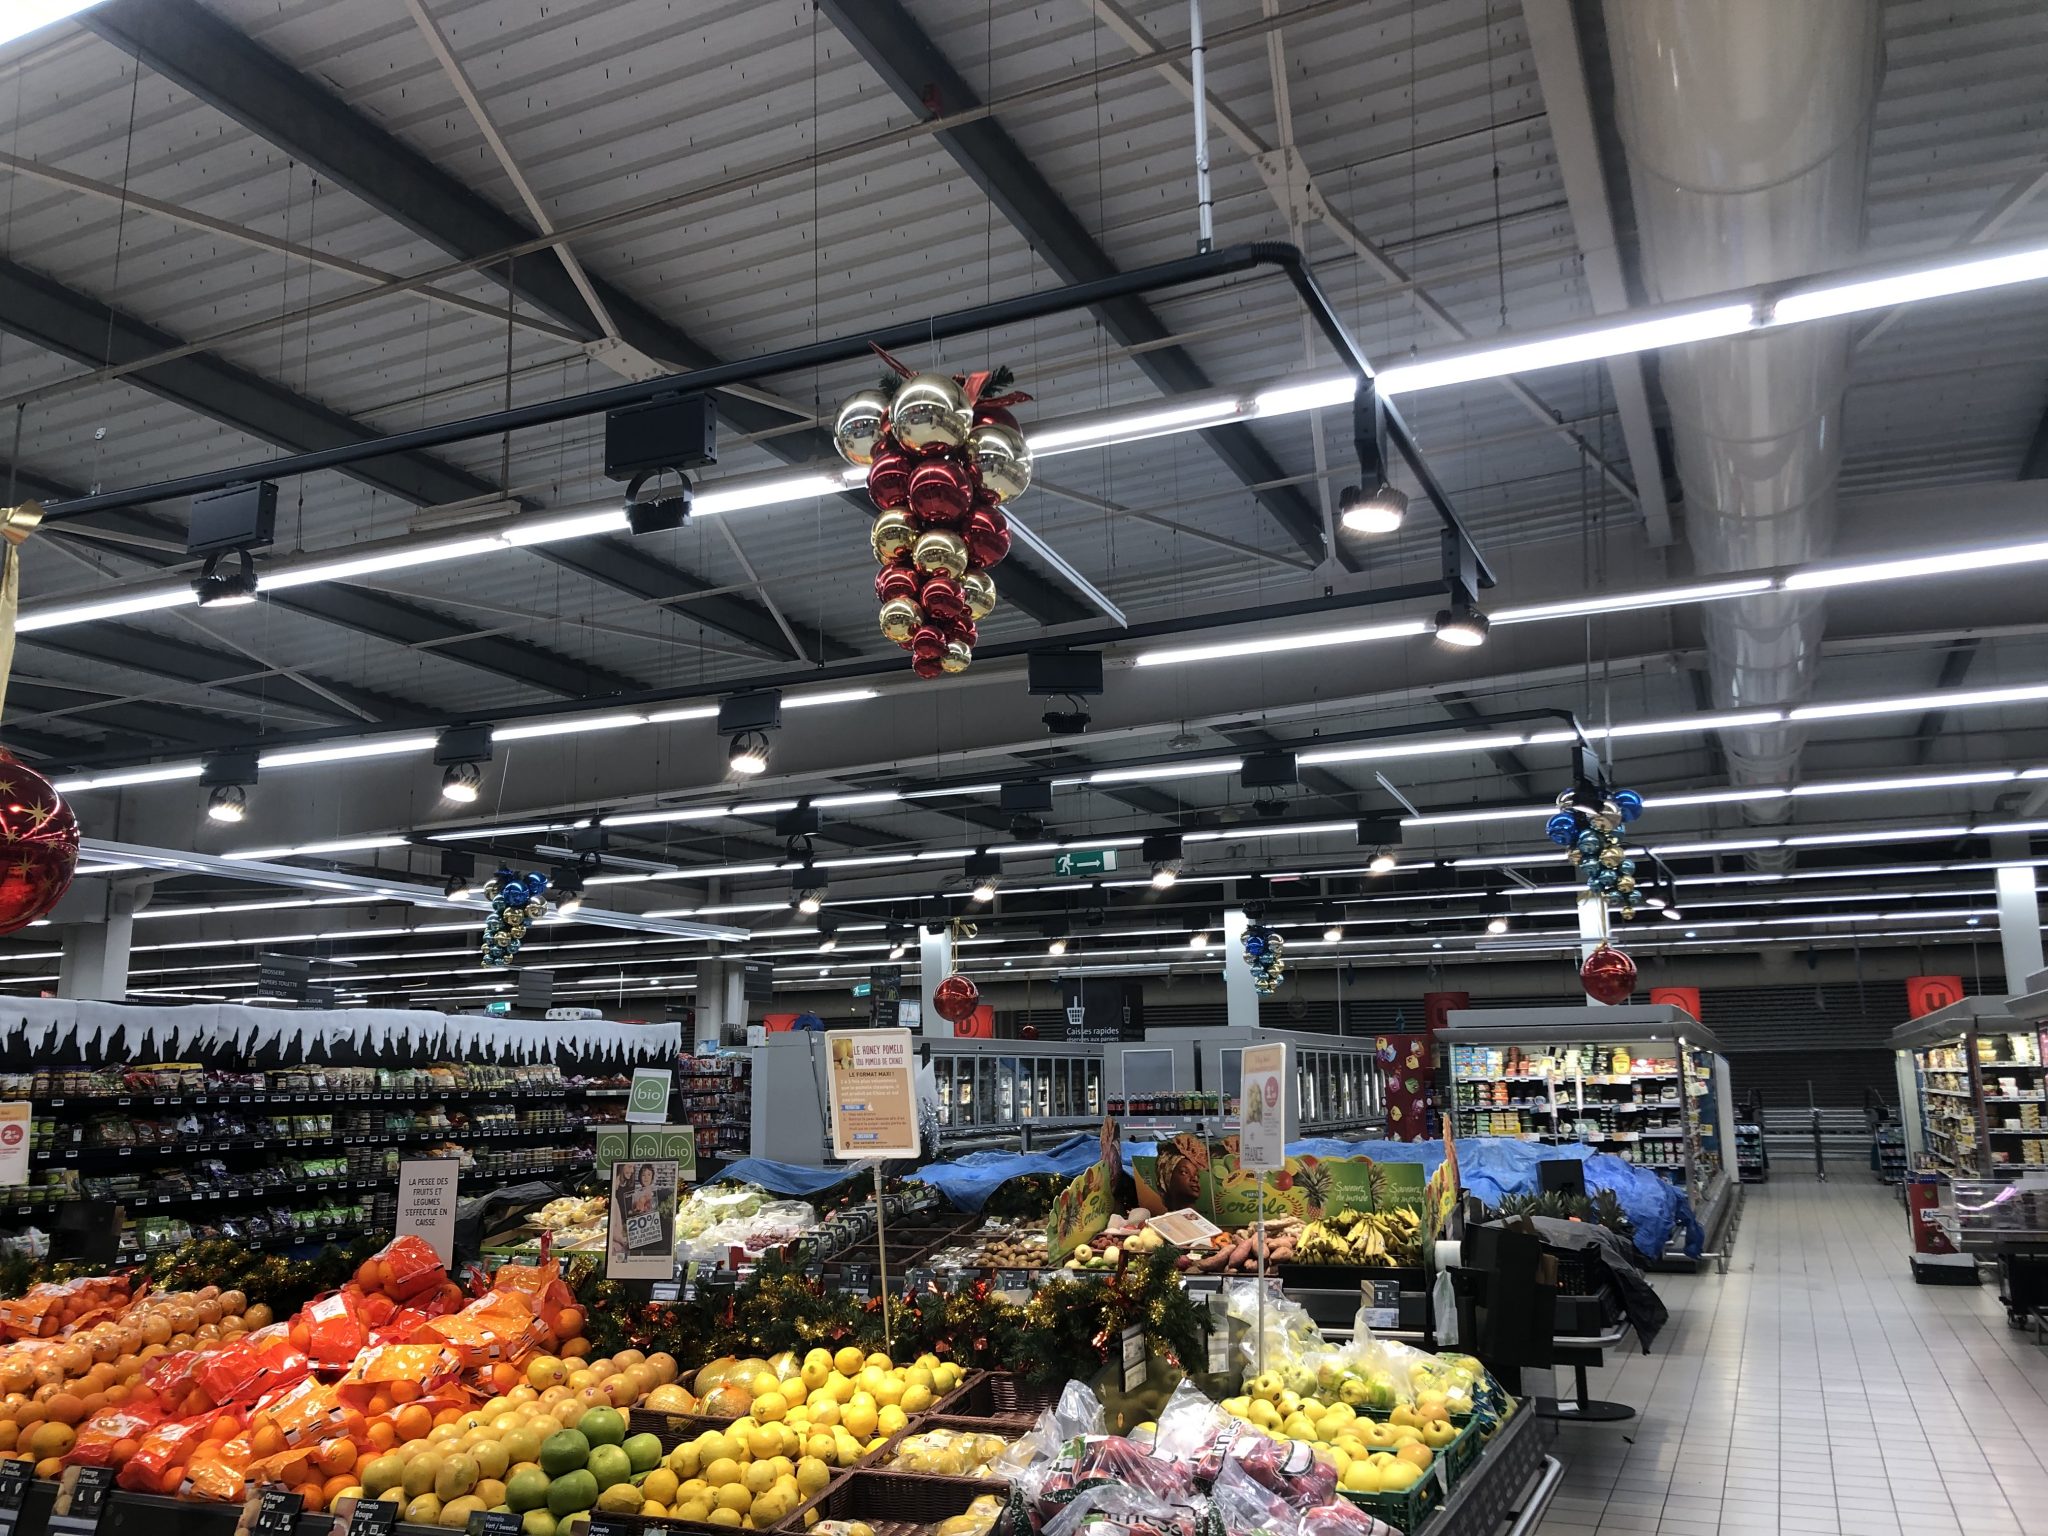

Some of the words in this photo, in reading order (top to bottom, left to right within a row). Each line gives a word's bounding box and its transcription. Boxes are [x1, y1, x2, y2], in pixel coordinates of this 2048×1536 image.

[1094, 1027, 1119, 1036] rapides
[854, 1046, 860, 1055] LE
[638, 1088, 660, 1100] bio
[602, 1144, 622, 1157] bio
[635, 1145, 655, 1157] bio
[668, 1146, 689, 1157] bio
[628, 1214, 659, 1232] 20%
[81, 1468, 98, 1478] Orange
[266, 1492, 285, 1502] Orange
[357, 1501, 378, 1509] Pomelo
[355, 1510, 374, 1519] Rouge
[499, 1523, 518, 1531] Sweetie
